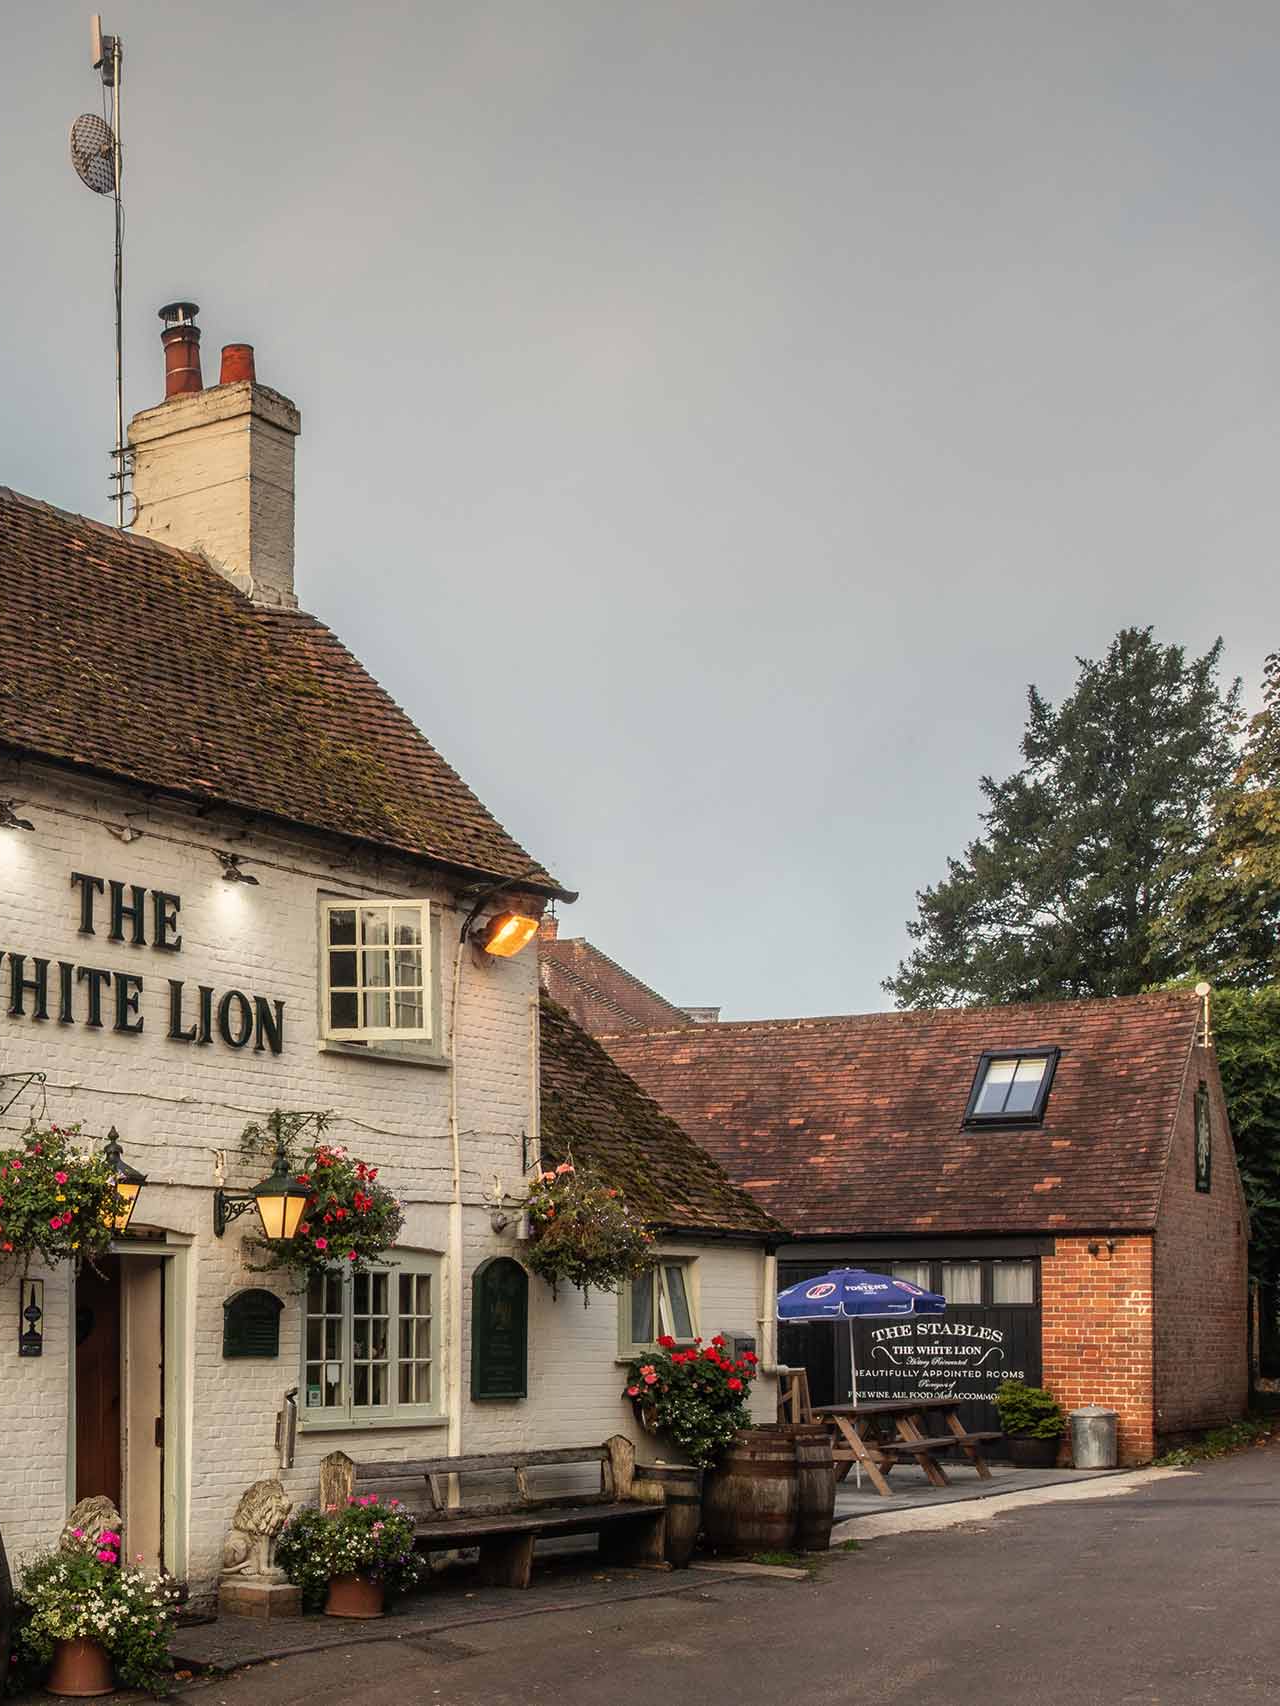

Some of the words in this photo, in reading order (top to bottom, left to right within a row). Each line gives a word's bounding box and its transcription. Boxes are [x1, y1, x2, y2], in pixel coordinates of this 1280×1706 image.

[70, 871, 183, 952] THE
[167, 978, 287, 1054] LION
[871, 1324, 912, 1342] THE
[917, 1323, 1003, 1343] STABLES
[892, 1345, 914, 1355] THE
[916, 1345, 953, 1355] WHITE
[954, 1345, 982, 1355] LION
[922, 1369, 982, 1378] APPOINTED
[986, 1370, 1025, 1379] ROOMS
[848, 1391, 867, 1399] FNE
[909, 1391, 933, 1399] FOOD
[952, 1392, 1000, 1400] ACCOMMO
